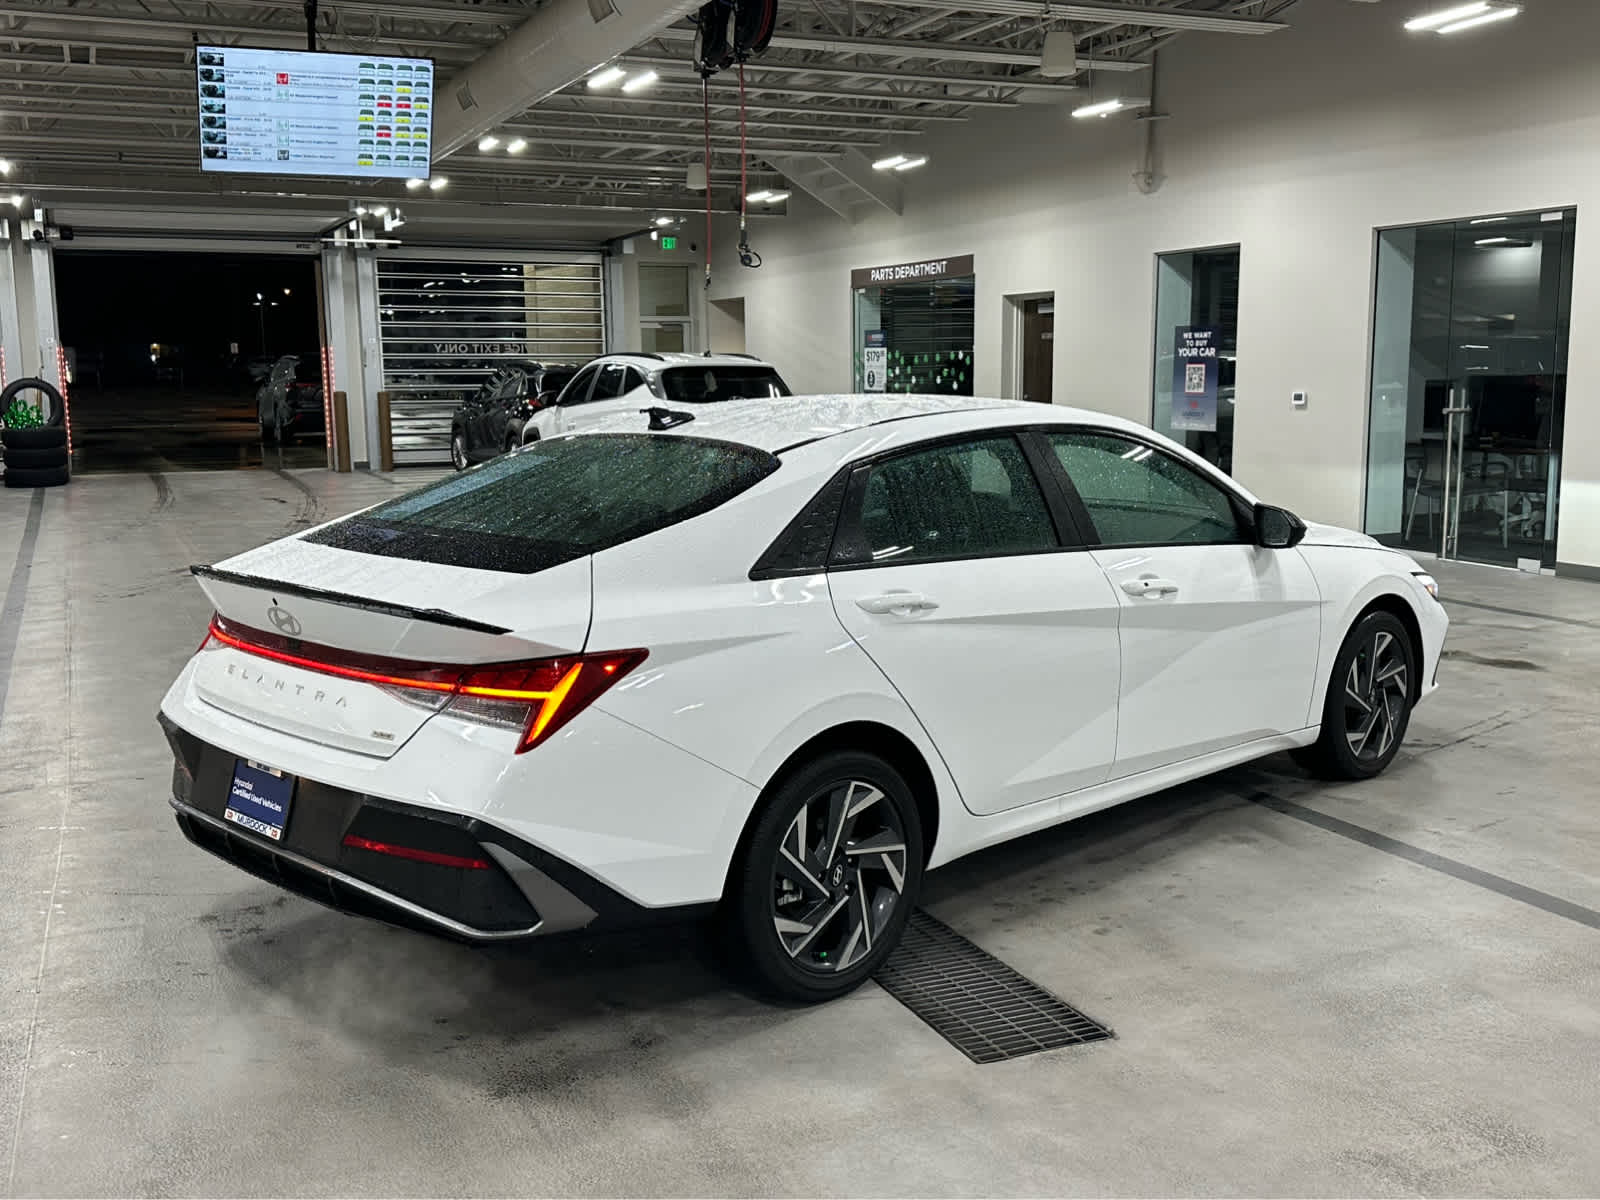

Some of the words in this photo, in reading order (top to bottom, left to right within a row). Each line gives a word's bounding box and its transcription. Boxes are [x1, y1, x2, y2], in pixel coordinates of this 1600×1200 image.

[871, 268, 894, 281] PARTS
[895, 261, 948, 279] DEPARTMENT
[1194, 331, 1212, 339] WANT
[1195, 339, 1208, 347] BUY
[1178, 347, 1198, 357] YOUR
[1199, 347, 1216, 357] CAR
[227, 663, 348, 708] ELANTRA
